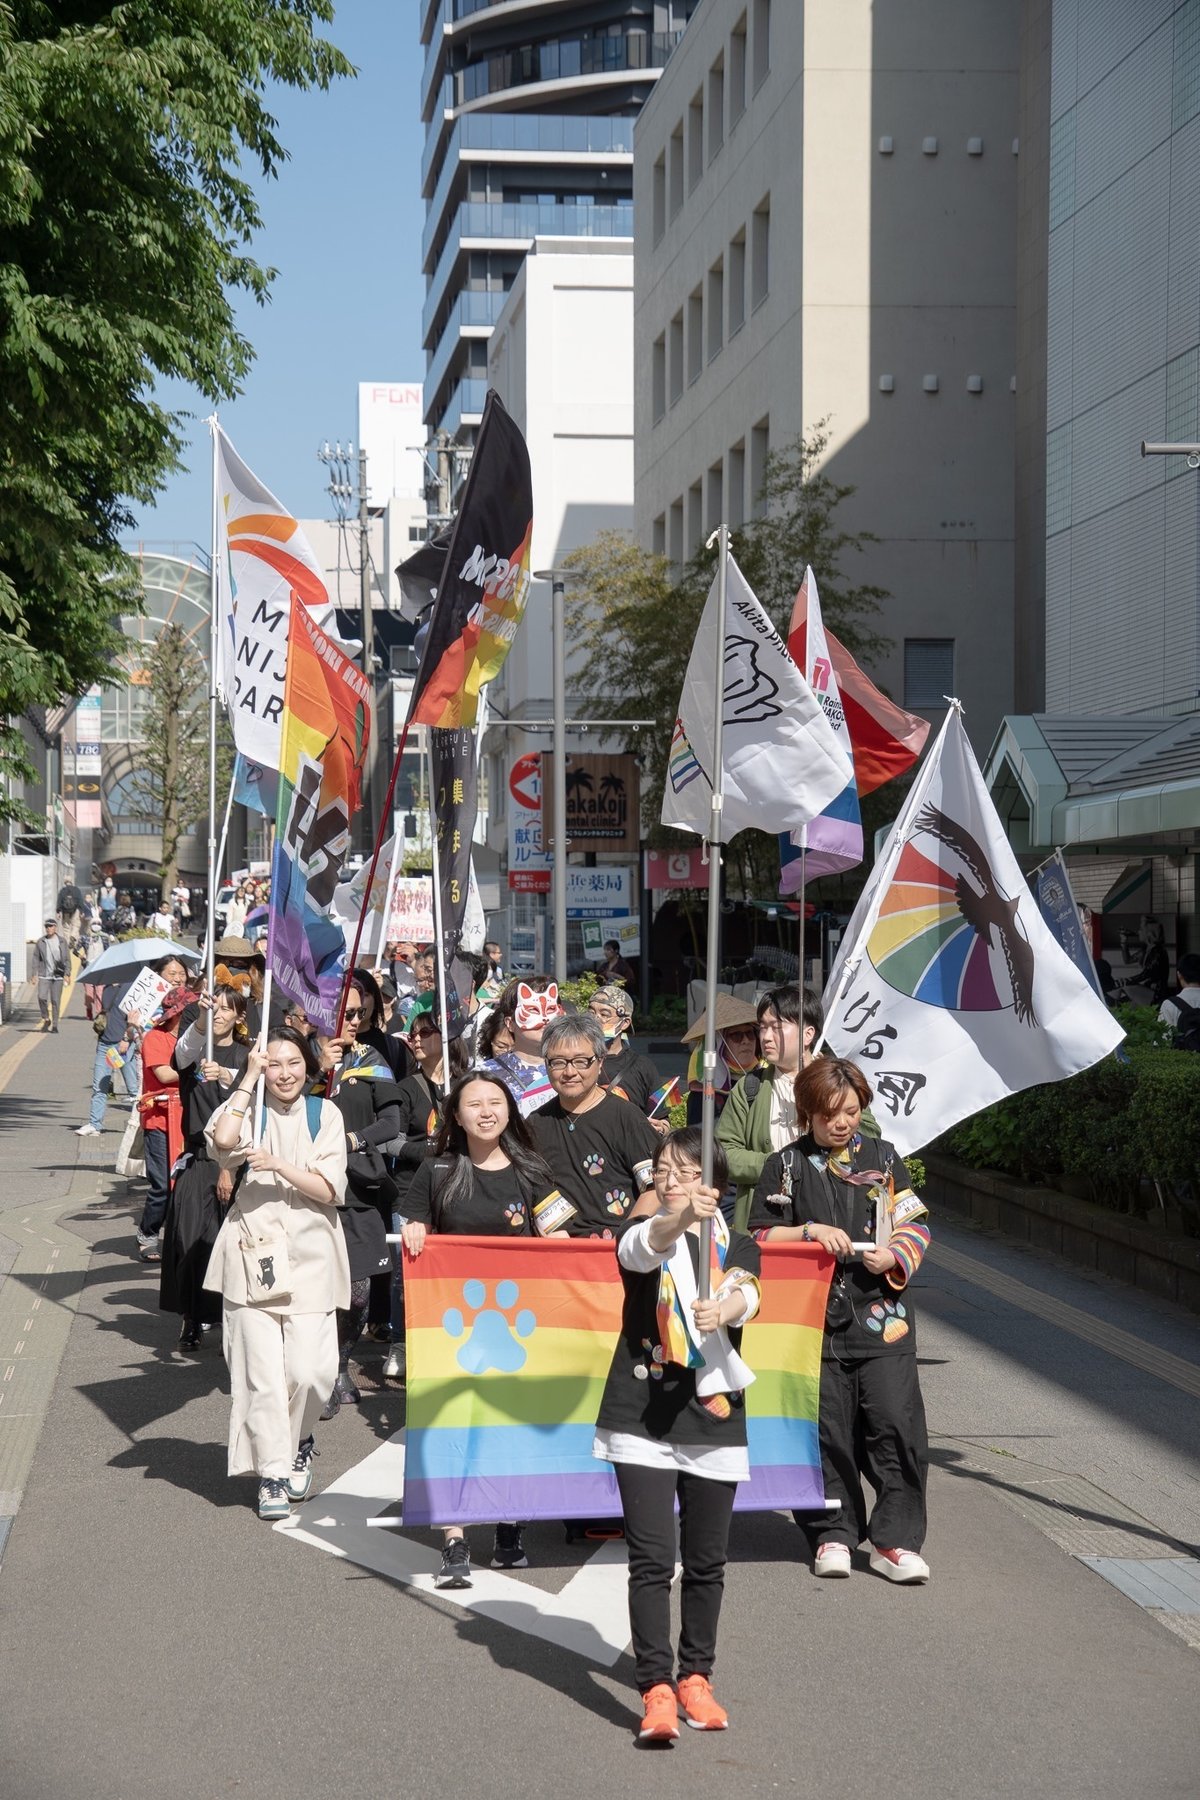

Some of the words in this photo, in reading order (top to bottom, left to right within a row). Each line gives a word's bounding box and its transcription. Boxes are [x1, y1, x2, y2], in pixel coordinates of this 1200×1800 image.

[732, 601, 769, 634] Akita
[79, 745, 99, 755] TBC
[568, 874, 587, 887] ife
[588, 874, 623, 892] 薬局
[841, 991, 927, 1117] ける風
